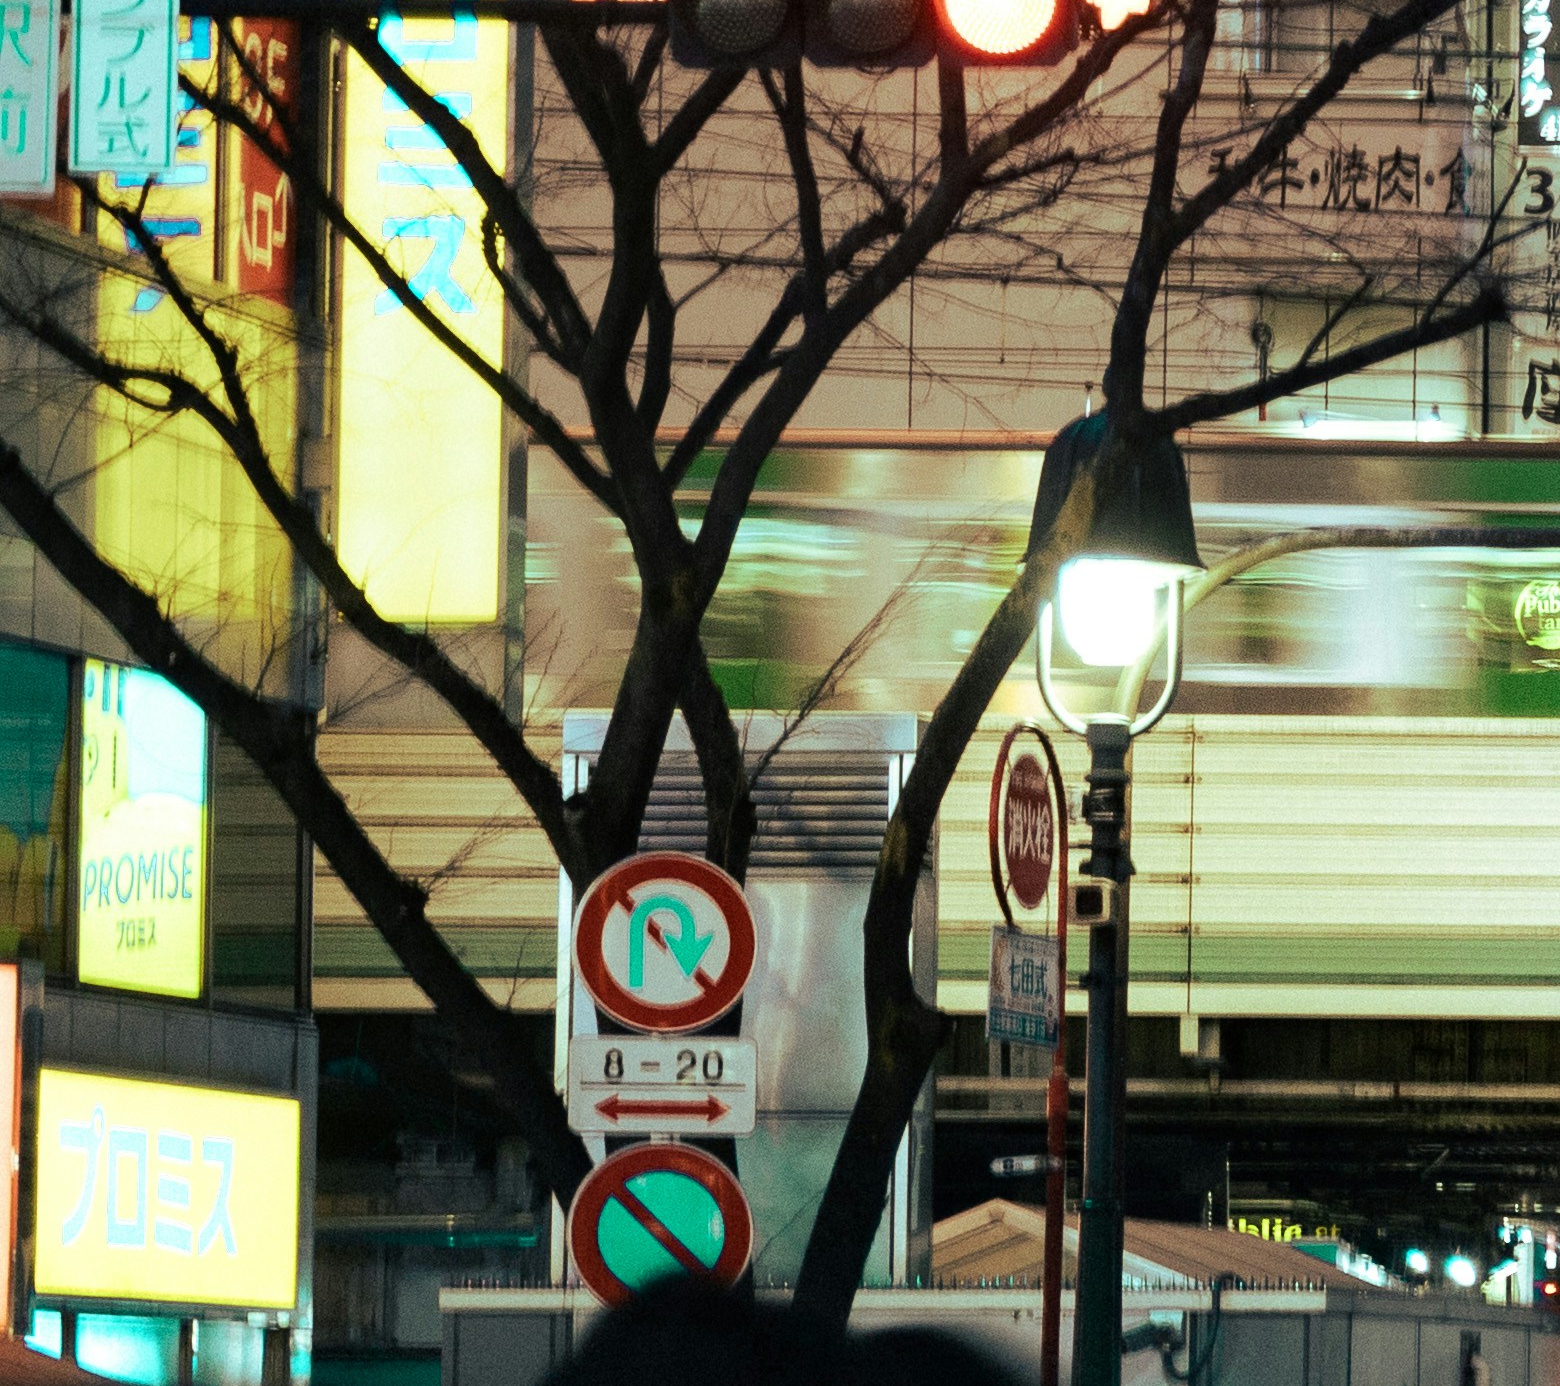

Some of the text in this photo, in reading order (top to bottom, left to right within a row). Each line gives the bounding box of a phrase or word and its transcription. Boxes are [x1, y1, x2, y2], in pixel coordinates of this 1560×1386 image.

[1009, 797, 1051, 865] 消火栓
[83, 846, 193, 911] PROMISE
[115, 915, 158, 951] プロミス
[603, 1050, 625, 1084] 8
[677, 1050, 724, 1084] 20
[60, 1103, 240, 1257] プロミス
